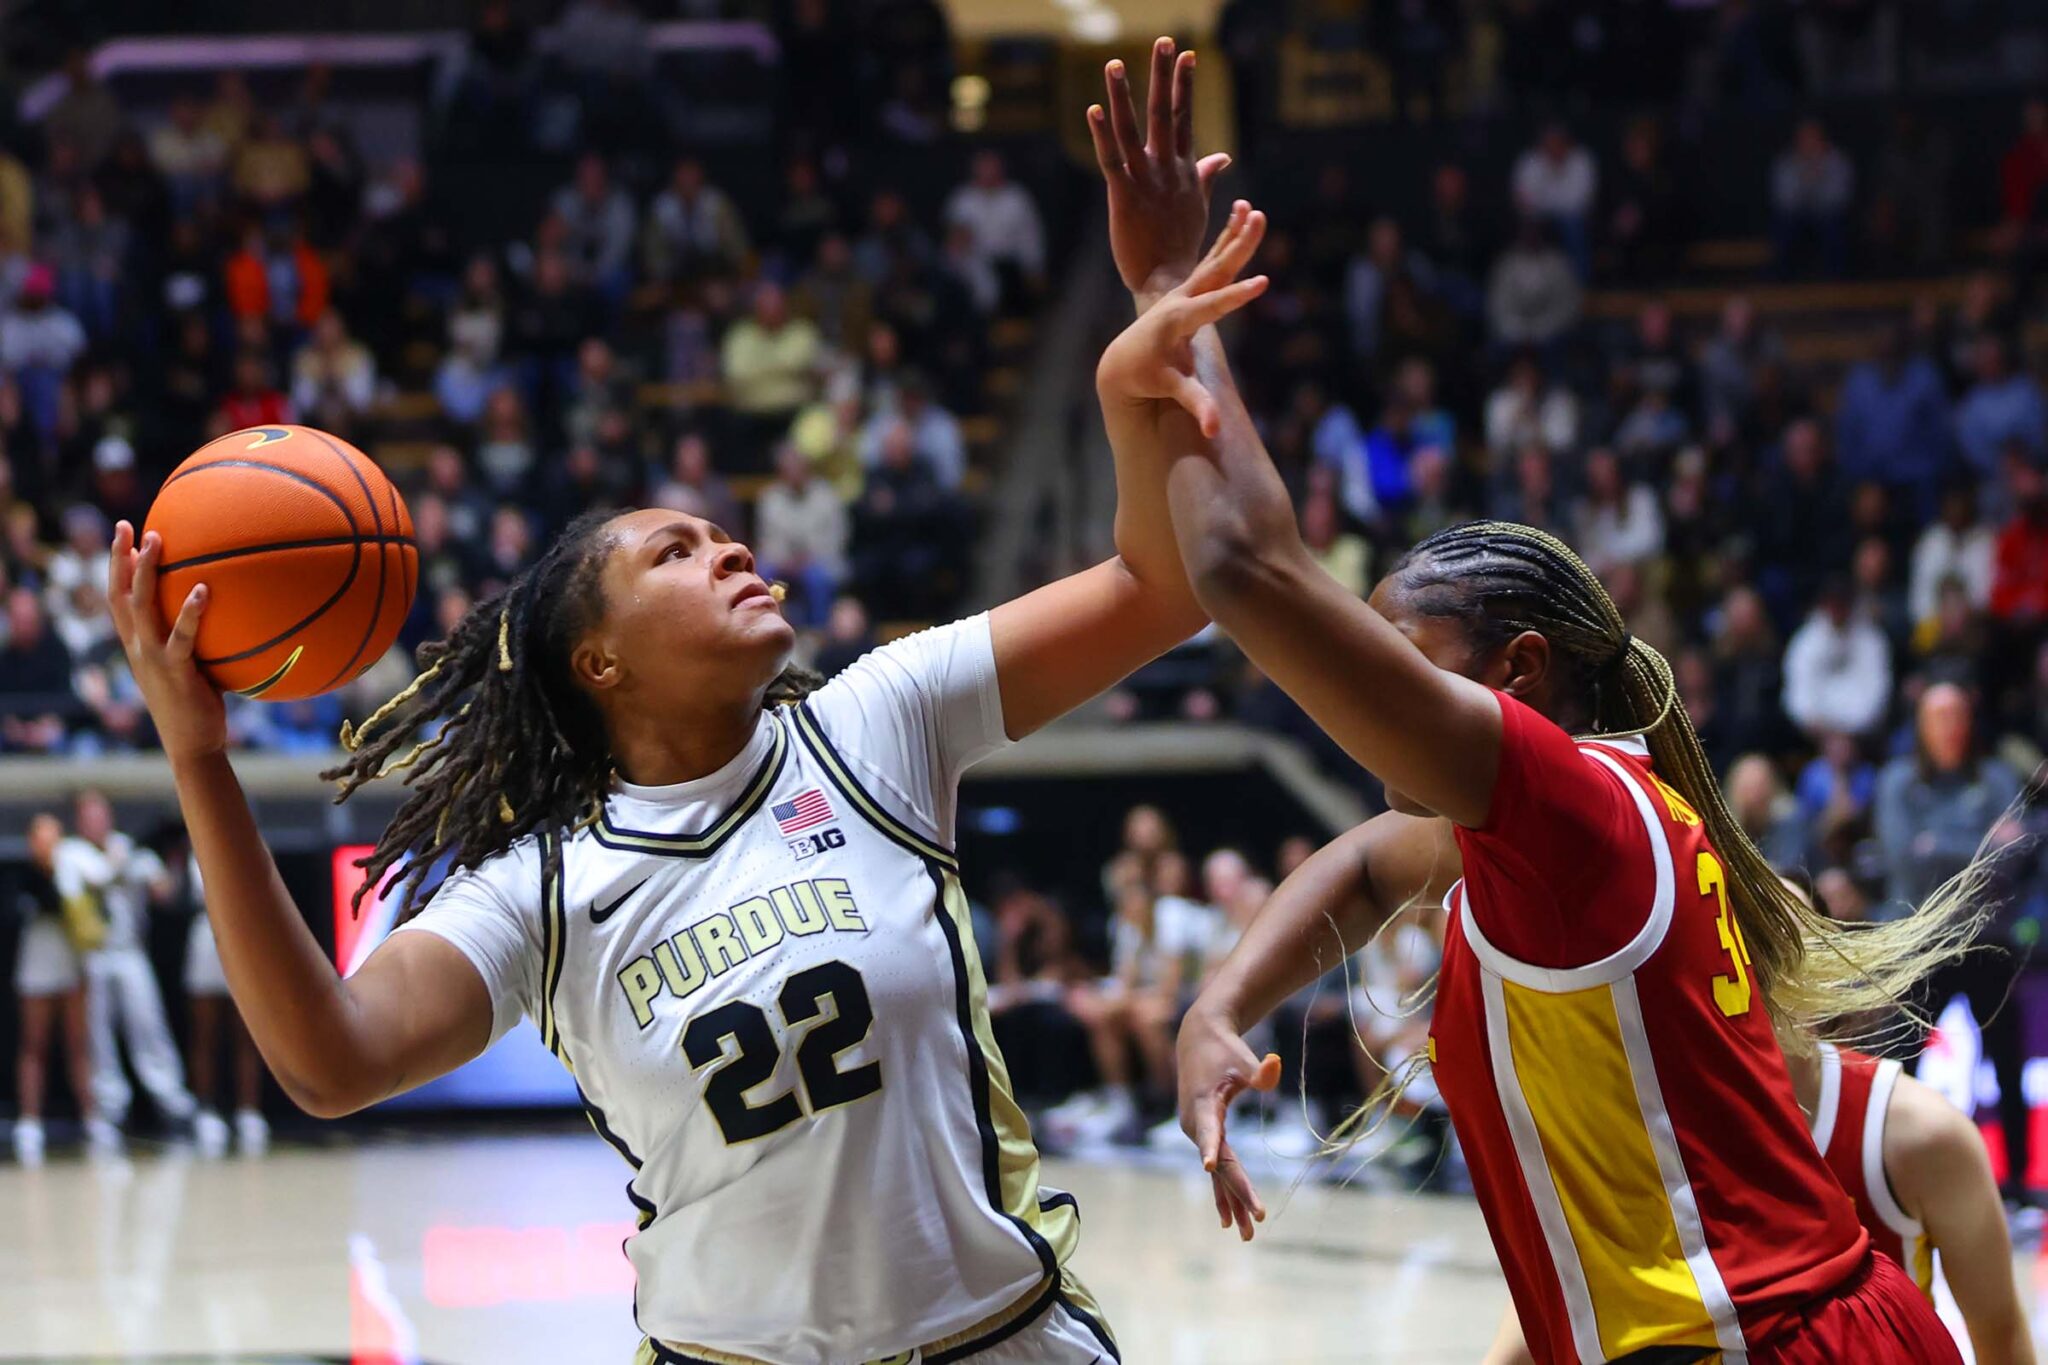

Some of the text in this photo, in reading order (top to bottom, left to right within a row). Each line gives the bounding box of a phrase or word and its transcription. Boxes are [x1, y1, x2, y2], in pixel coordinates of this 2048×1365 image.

[617, 878, 868, 1030] PURDUE
[1697, 852, 1751, 1017] 3
[678, 959, 883, 1148] 22
